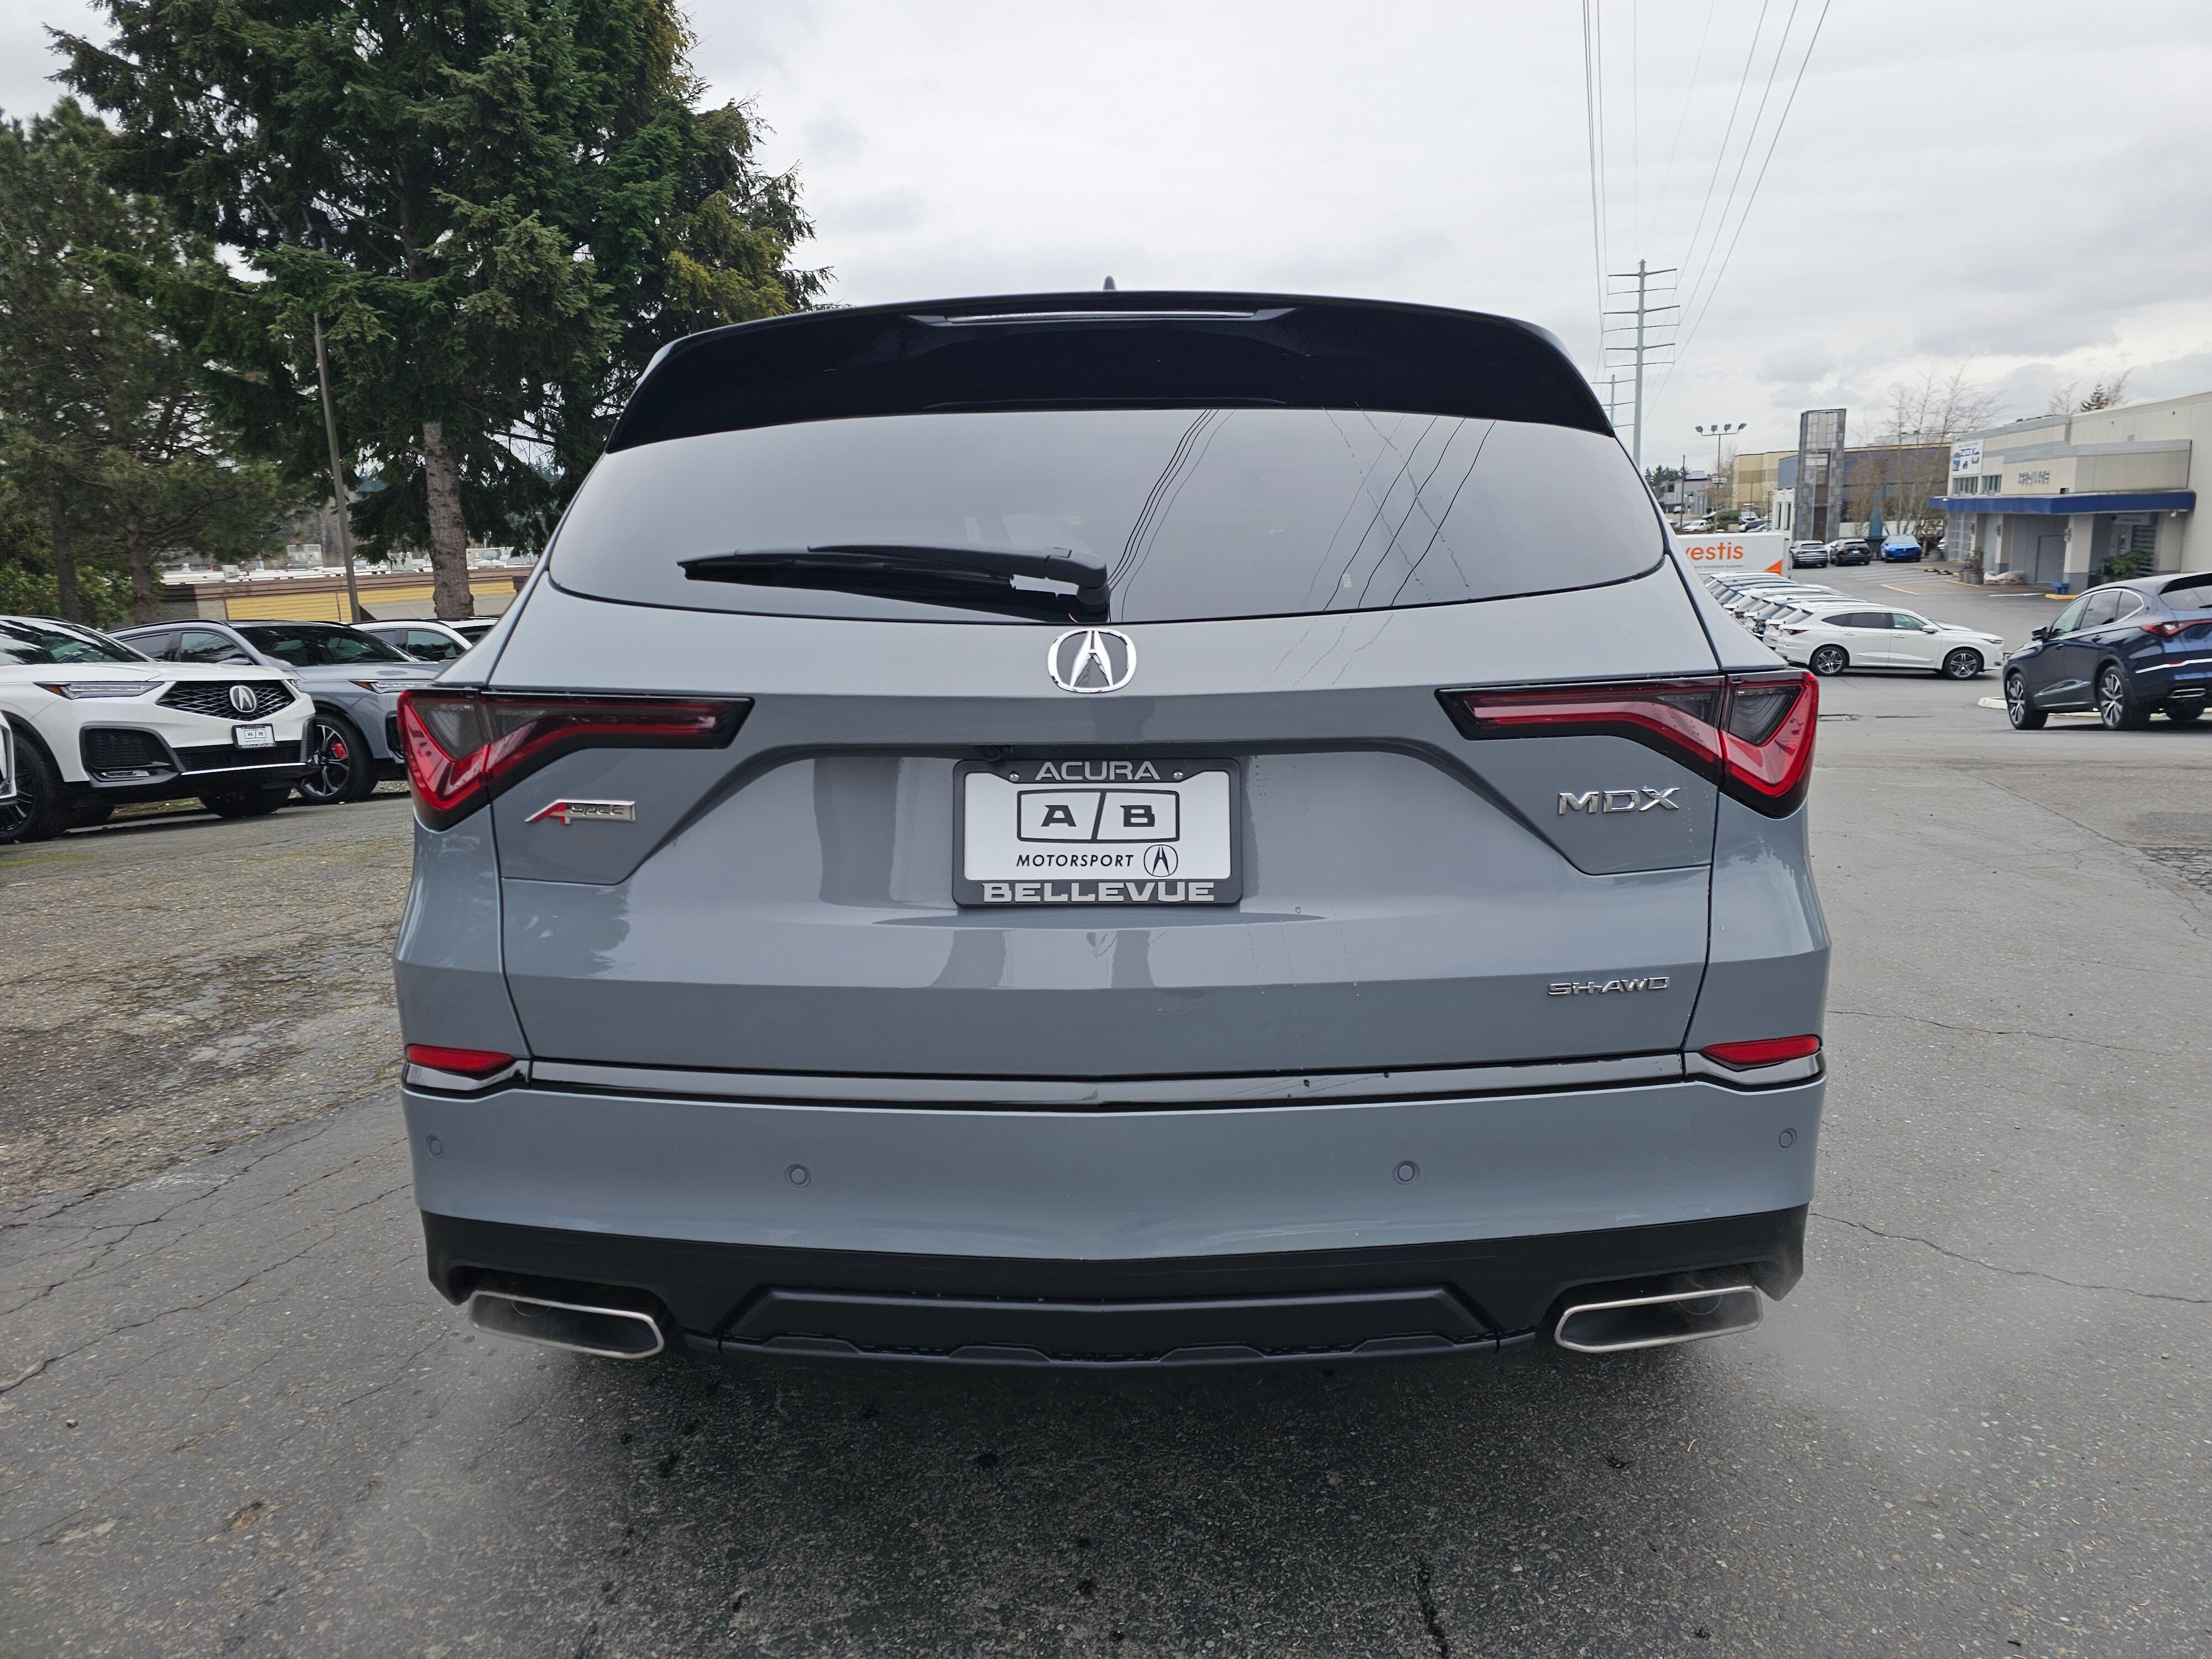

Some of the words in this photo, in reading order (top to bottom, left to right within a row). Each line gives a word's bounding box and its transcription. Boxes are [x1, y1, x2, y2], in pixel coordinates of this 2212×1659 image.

[1035, 761, 1160, 781] ACURA
[1557, 787, 1681, 815] MDX
[1041, 805, 1077, 827] A
[1119, 805, 1155, 827] B
[1016, 854, 1134, 867] MOTORSPORT
[982, 881, 1215, 902] BELLEVUE
